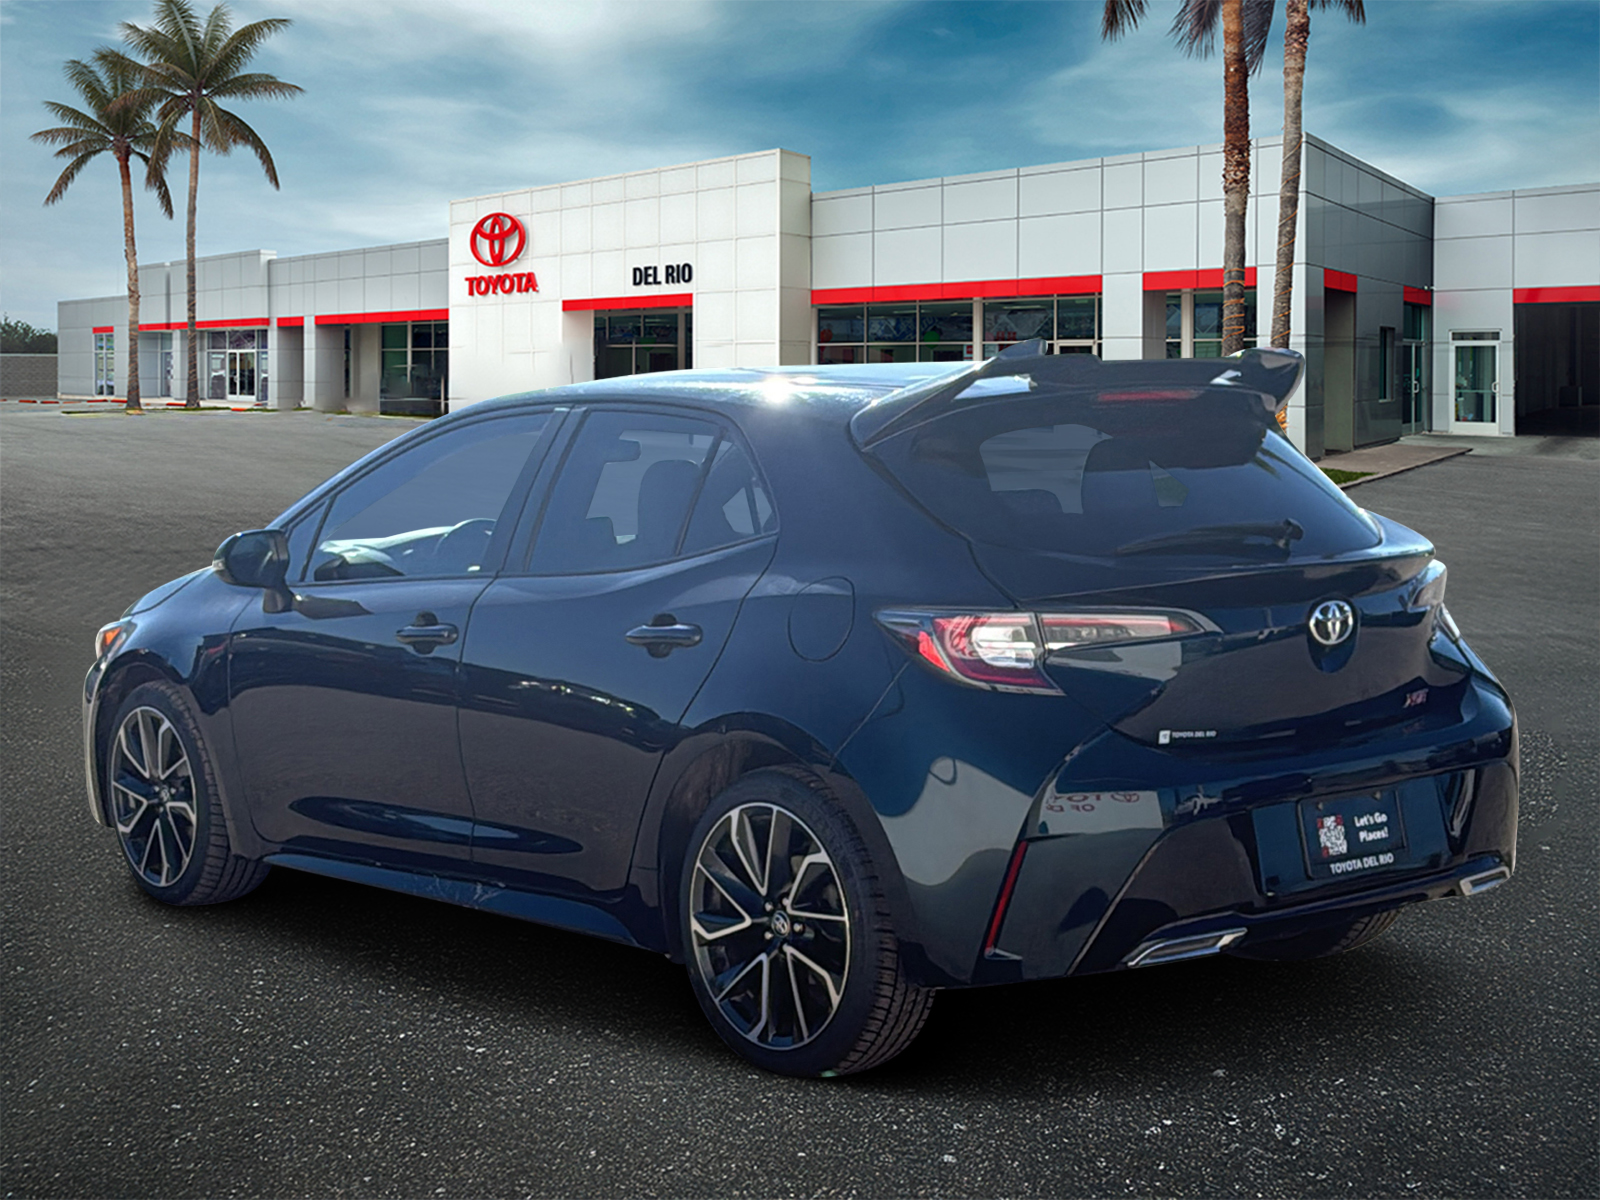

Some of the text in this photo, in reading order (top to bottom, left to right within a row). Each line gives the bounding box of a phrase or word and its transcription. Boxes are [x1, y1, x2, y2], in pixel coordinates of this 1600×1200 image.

[465, 272, 538, 296] TOYOTA
[632, 263, 693, 286] DEL RIO
[1354, 812, 1387, 827] Let's Go
[1359, 827, 1388, 842] Places!
[1330, 852, 1394, 874] TOYOTA DEL RIO
